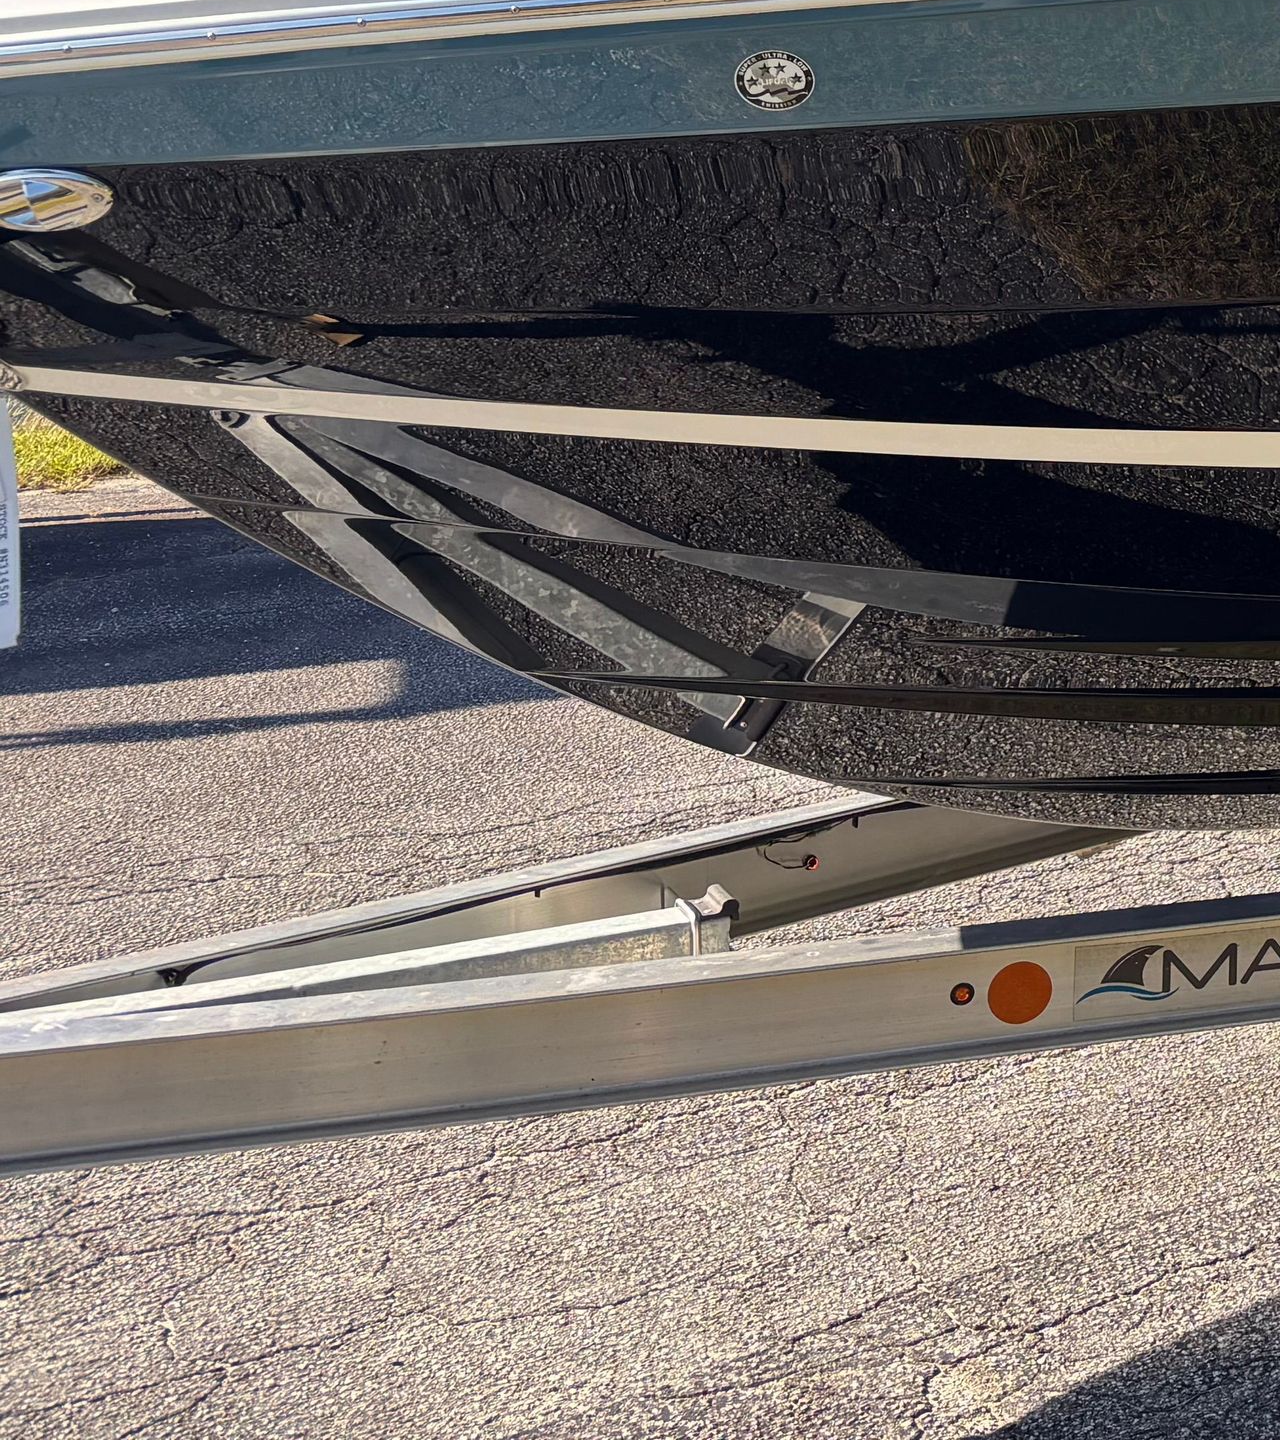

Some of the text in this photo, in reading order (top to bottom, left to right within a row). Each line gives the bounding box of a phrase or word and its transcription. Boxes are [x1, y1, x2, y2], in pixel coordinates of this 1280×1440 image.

[739, 52, 808, 75] SUPER ULTRA LOW
